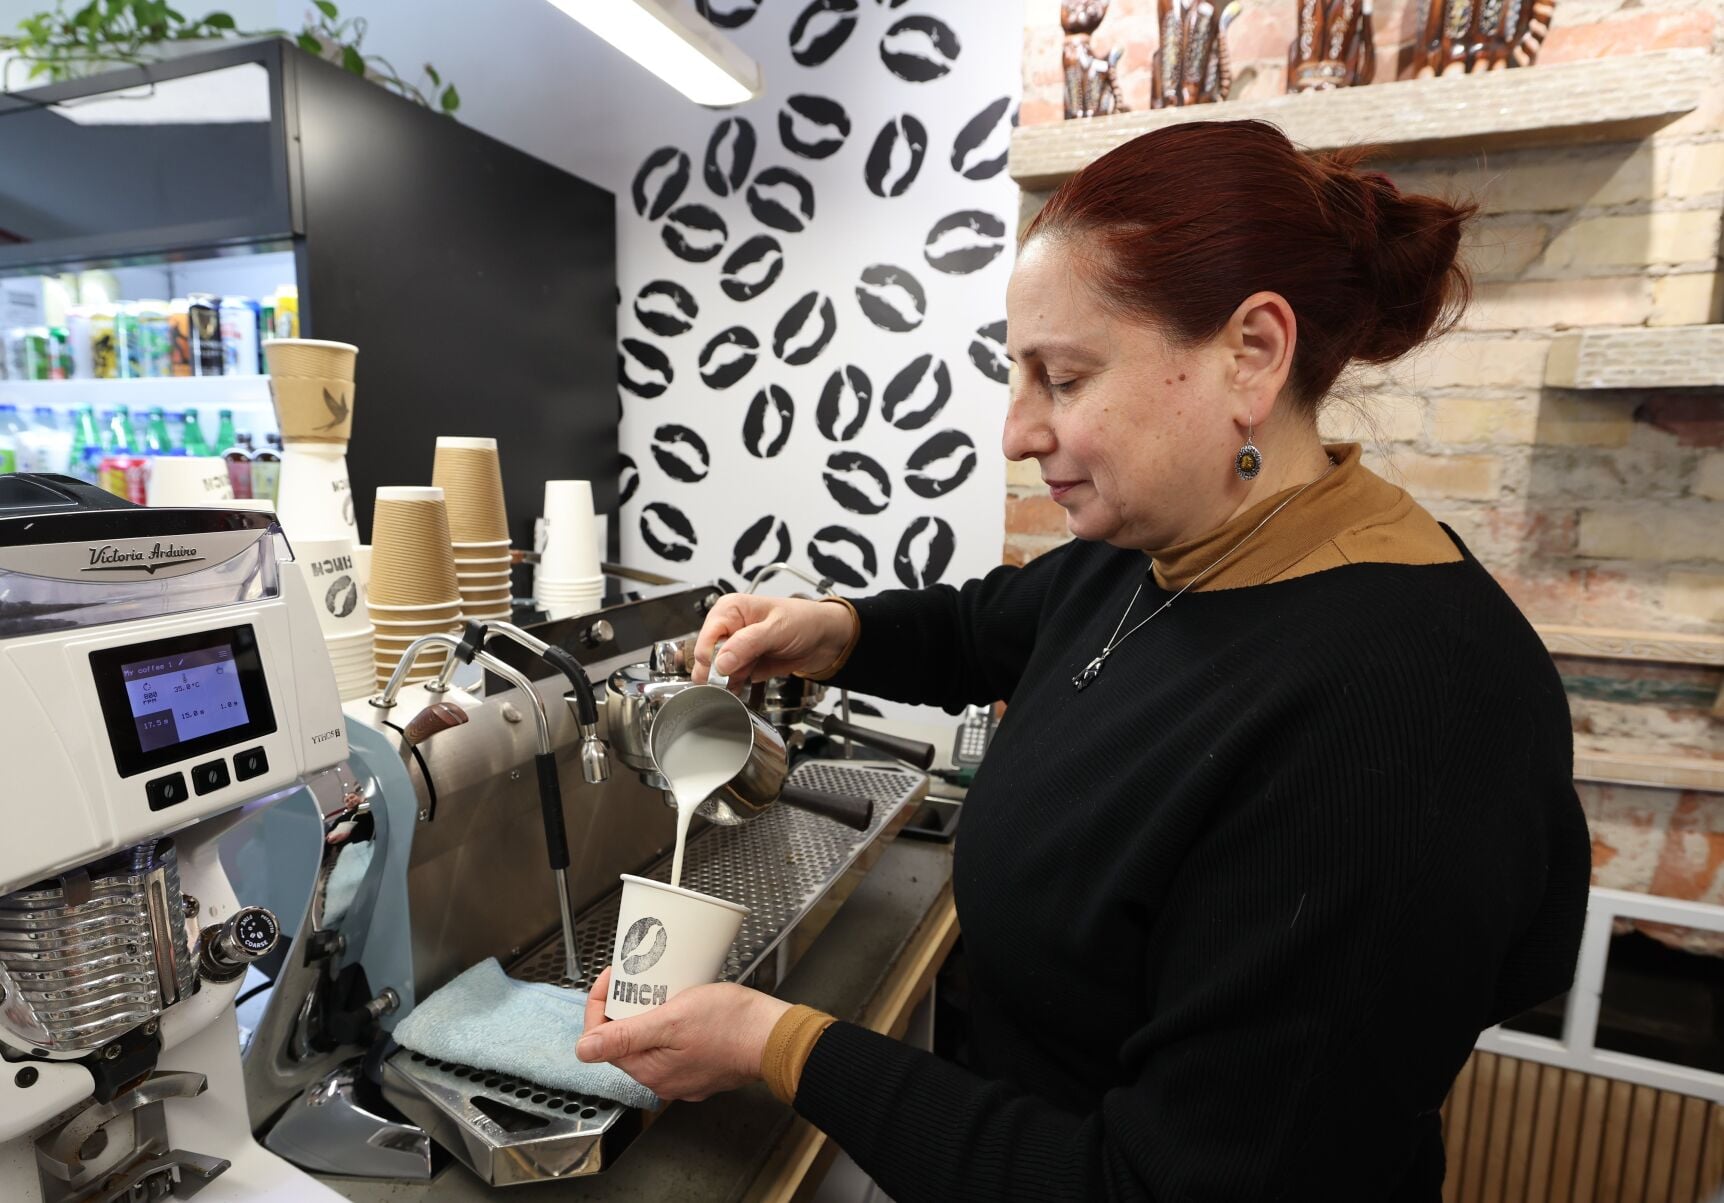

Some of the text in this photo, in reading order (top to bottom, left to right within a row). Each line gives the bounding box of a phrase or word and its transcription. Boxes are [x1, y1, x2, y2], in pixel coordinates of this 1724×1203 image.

[88, 542, 198, 565] Victoria Arduino
[138, 664, 165, 674] coffee
[244, 939, 269, 948] COARSE
[613, 979, 668, 1006] FINCH
